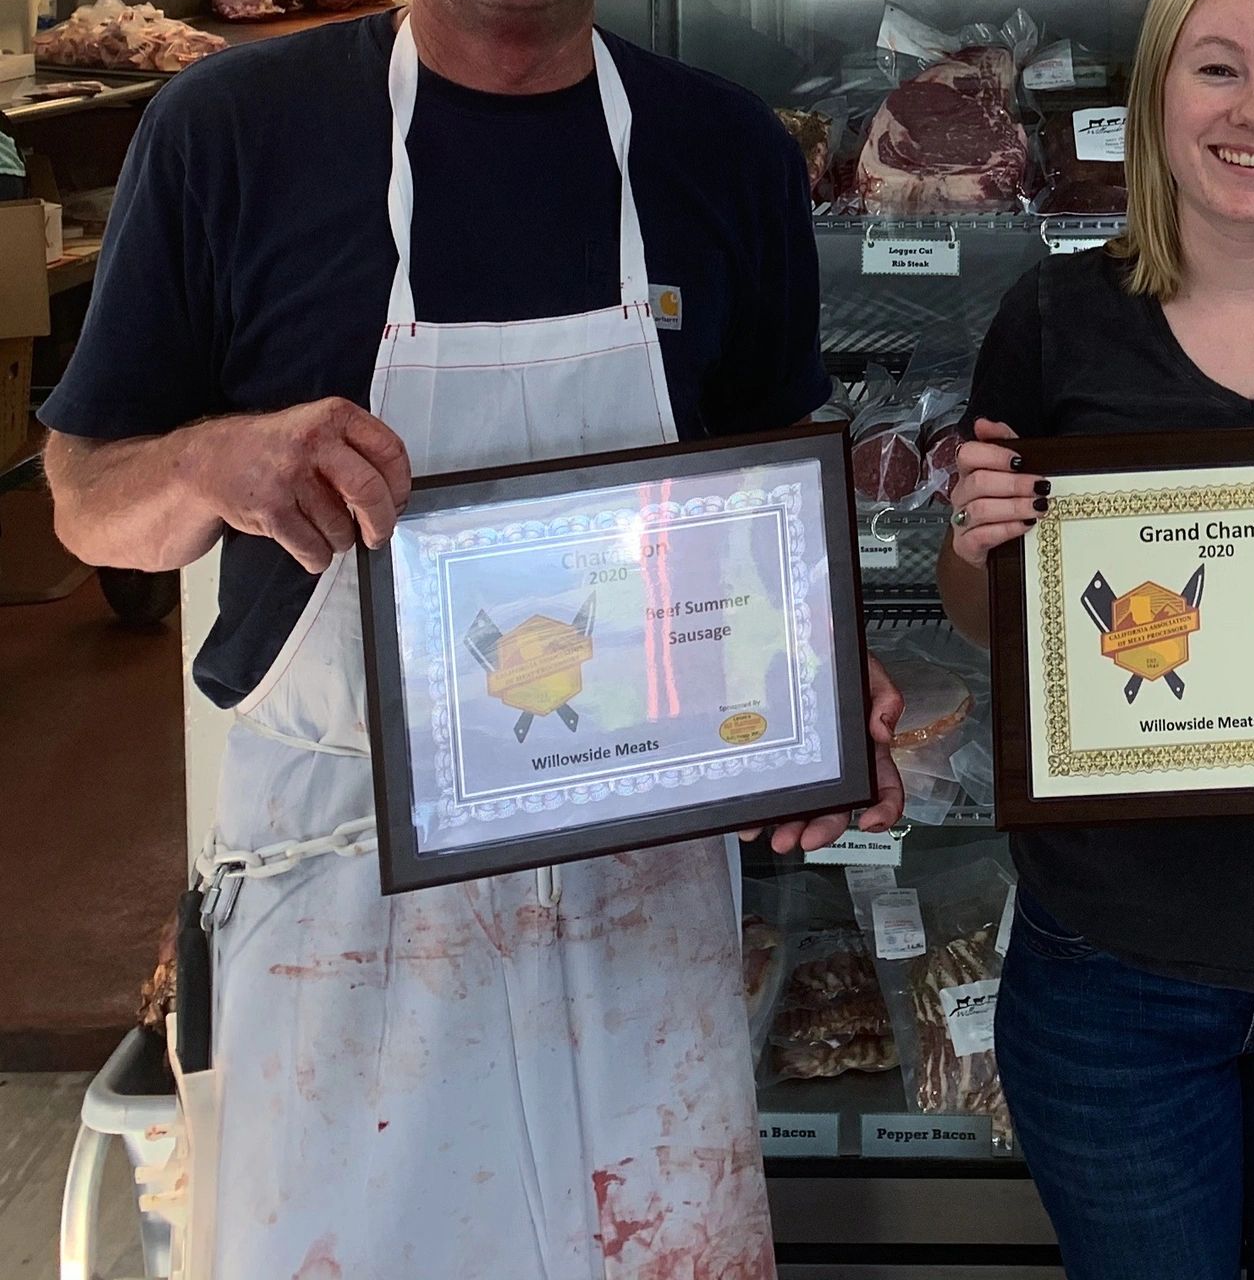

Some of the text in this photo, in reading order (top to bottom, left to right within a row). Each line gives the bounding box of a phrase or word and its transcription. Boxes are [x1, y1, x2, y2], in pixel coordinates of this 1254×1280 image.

[888, 247, 933, 256] Logger Cut
[891, 260, 930, 268] Rib Steak
[1139, 522, 1200, 543] Grand
[1198, 544, 1235, 559] 2020
[589, 567, 628, 585] 2020
[646, 594, 750, 620] Beef Summer
[668, 624, 732, 646] Sausage
[1108, 615, 1192, 641] CALIFORNIA ASSOCIATION
[1127, 635, 1145, 645] MEAT
[1146, 624, 1188, 640] PROCESSORS
[1139, 716, 1214, 734] Willowside
[531, 739, 660, 771] Willowside Meats
[868, 842, 892, 850] Slices
[771, 1126, 817, 1138] Bacon
[876, 1128, 976, 1143] Pepper Bacon
